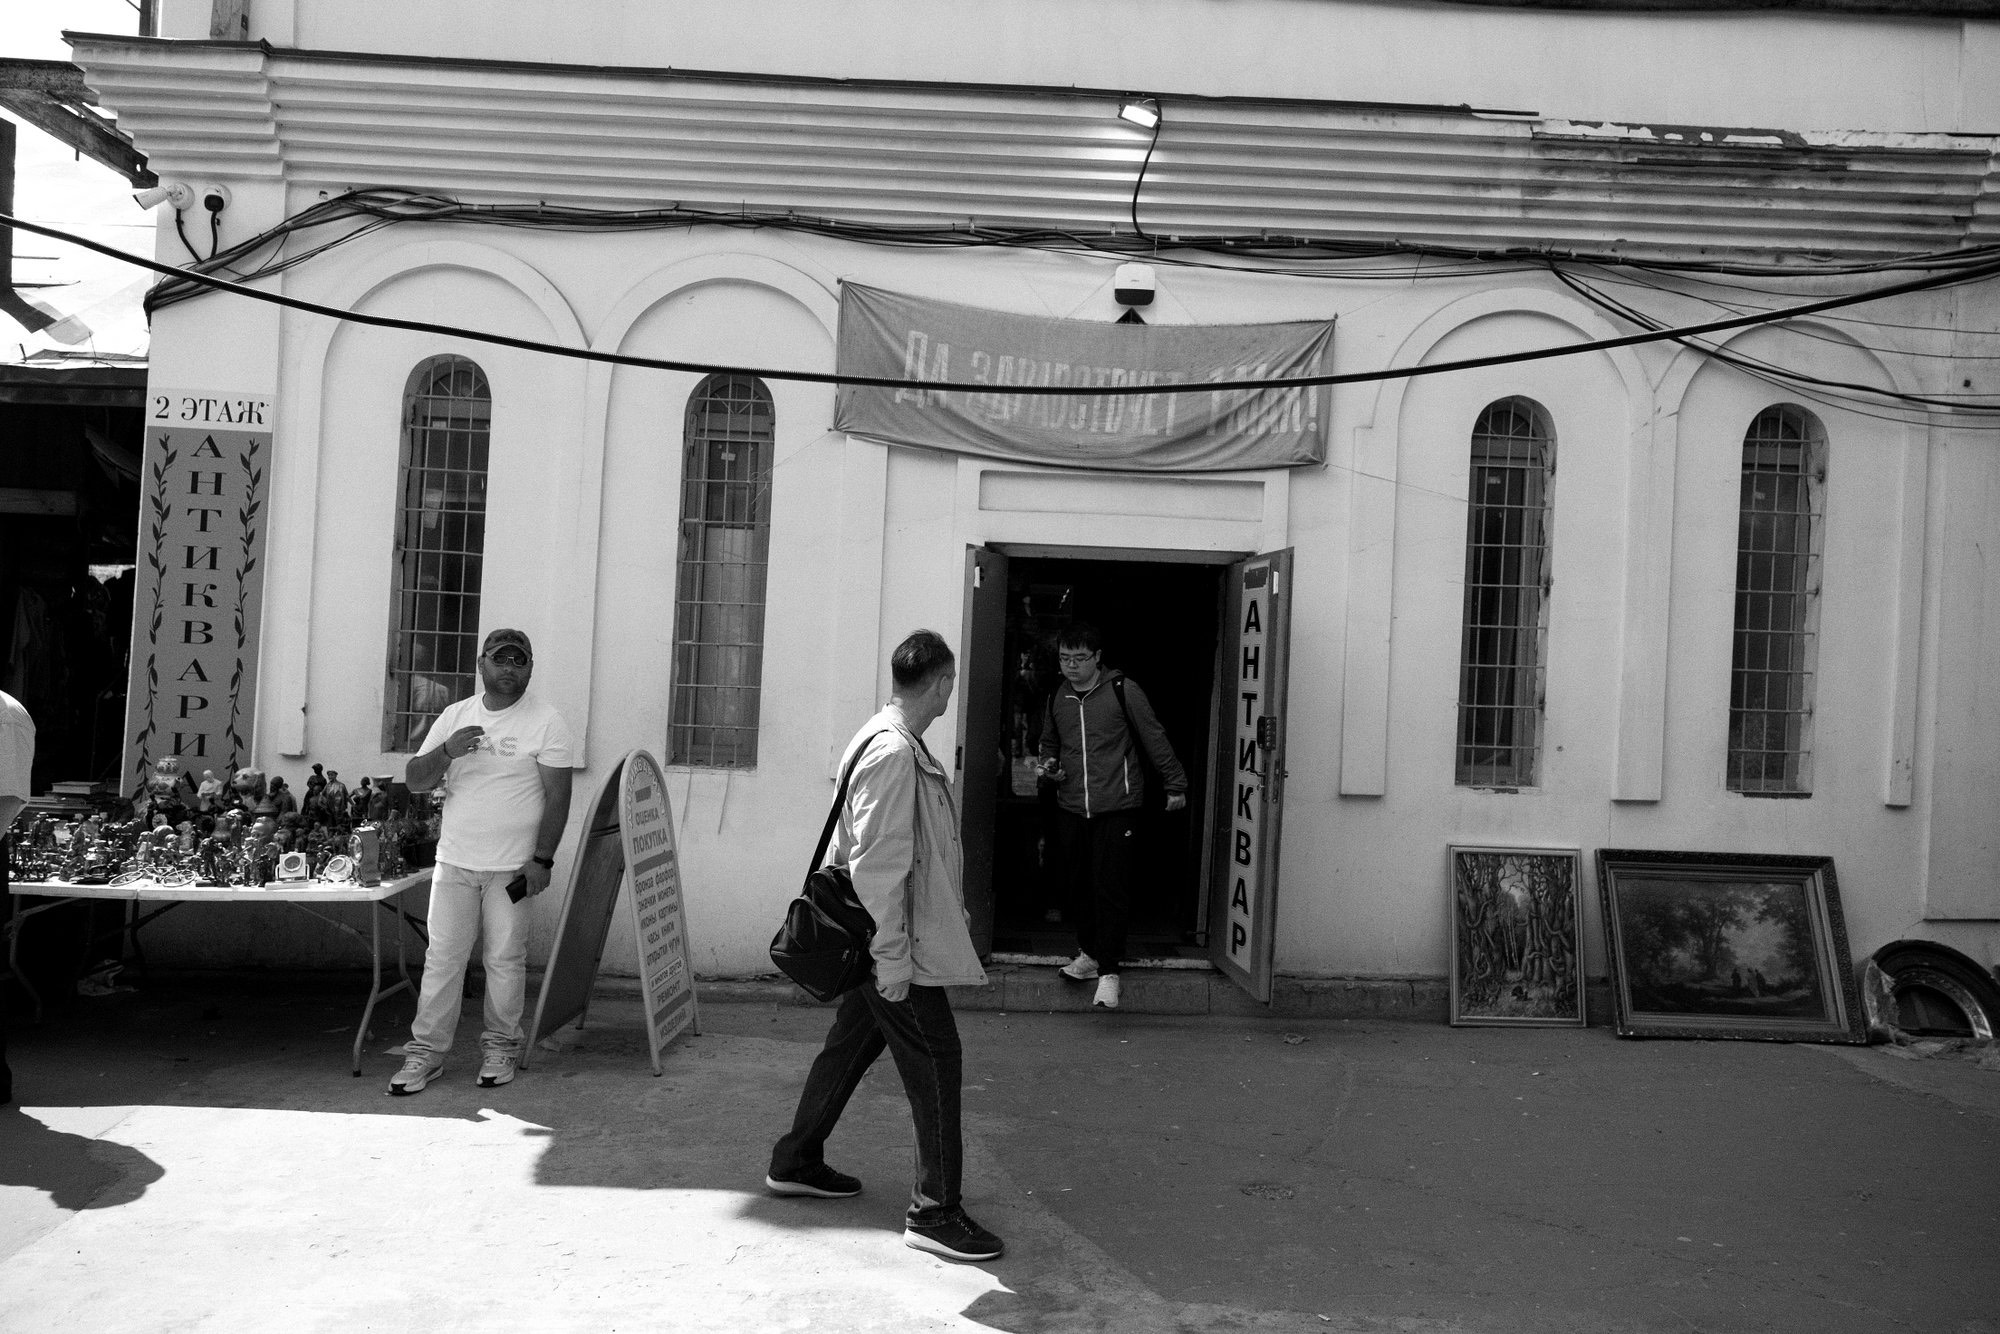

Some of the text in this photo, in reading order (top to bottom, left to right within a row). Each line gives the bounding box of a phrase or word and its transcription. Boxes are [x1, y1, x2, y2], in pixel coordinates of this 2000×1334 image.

[894, 329, 950, 409] ДА
[155, 396, 265, 424] 2 ЭТАЖ
[169, 434, 227, 795] АНТИКВАРИА
[1230, 599, 1261, 957] АНТИКВАР
[635, 808, 660, 826] ОЦЕНКА
[633, 828, 668, 855] ПОКУПКА
[657, 980, 681, 1003] РЕМОНТ
